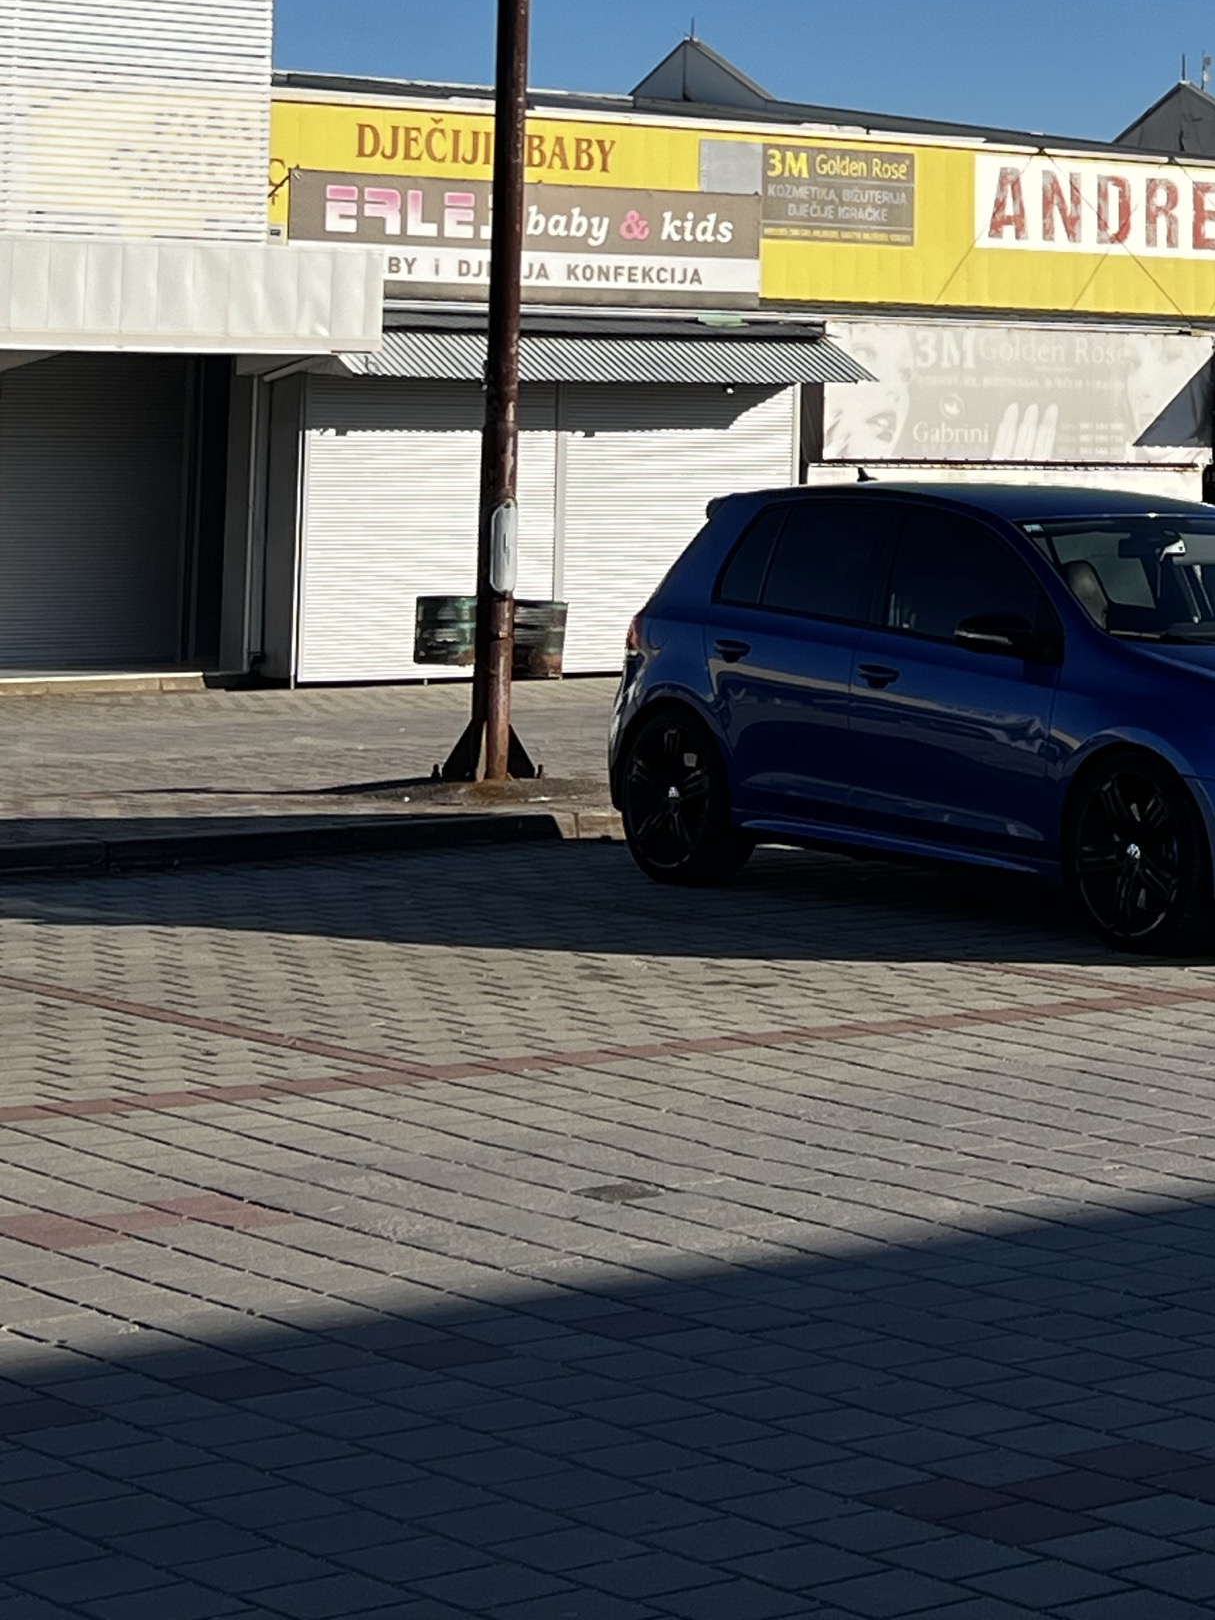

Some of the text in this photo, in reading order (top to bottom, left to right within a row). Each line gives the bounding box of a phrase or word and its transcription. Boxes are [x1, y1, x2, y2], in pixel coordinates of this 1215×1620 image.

[526, 135, 616, 173] BABY
[766, 148, 909, 181] 3M Golden Rose
[526, 205, 610, 247] baby
[618, 210, 650, 241] &
[660, 211, 734, 244] kids
[566, 263, 703, 285] KONFEKCIJA
[915, 331, 1131, 370] 3M Golden Rose
[912, 420, 991, 444] Gabrini
